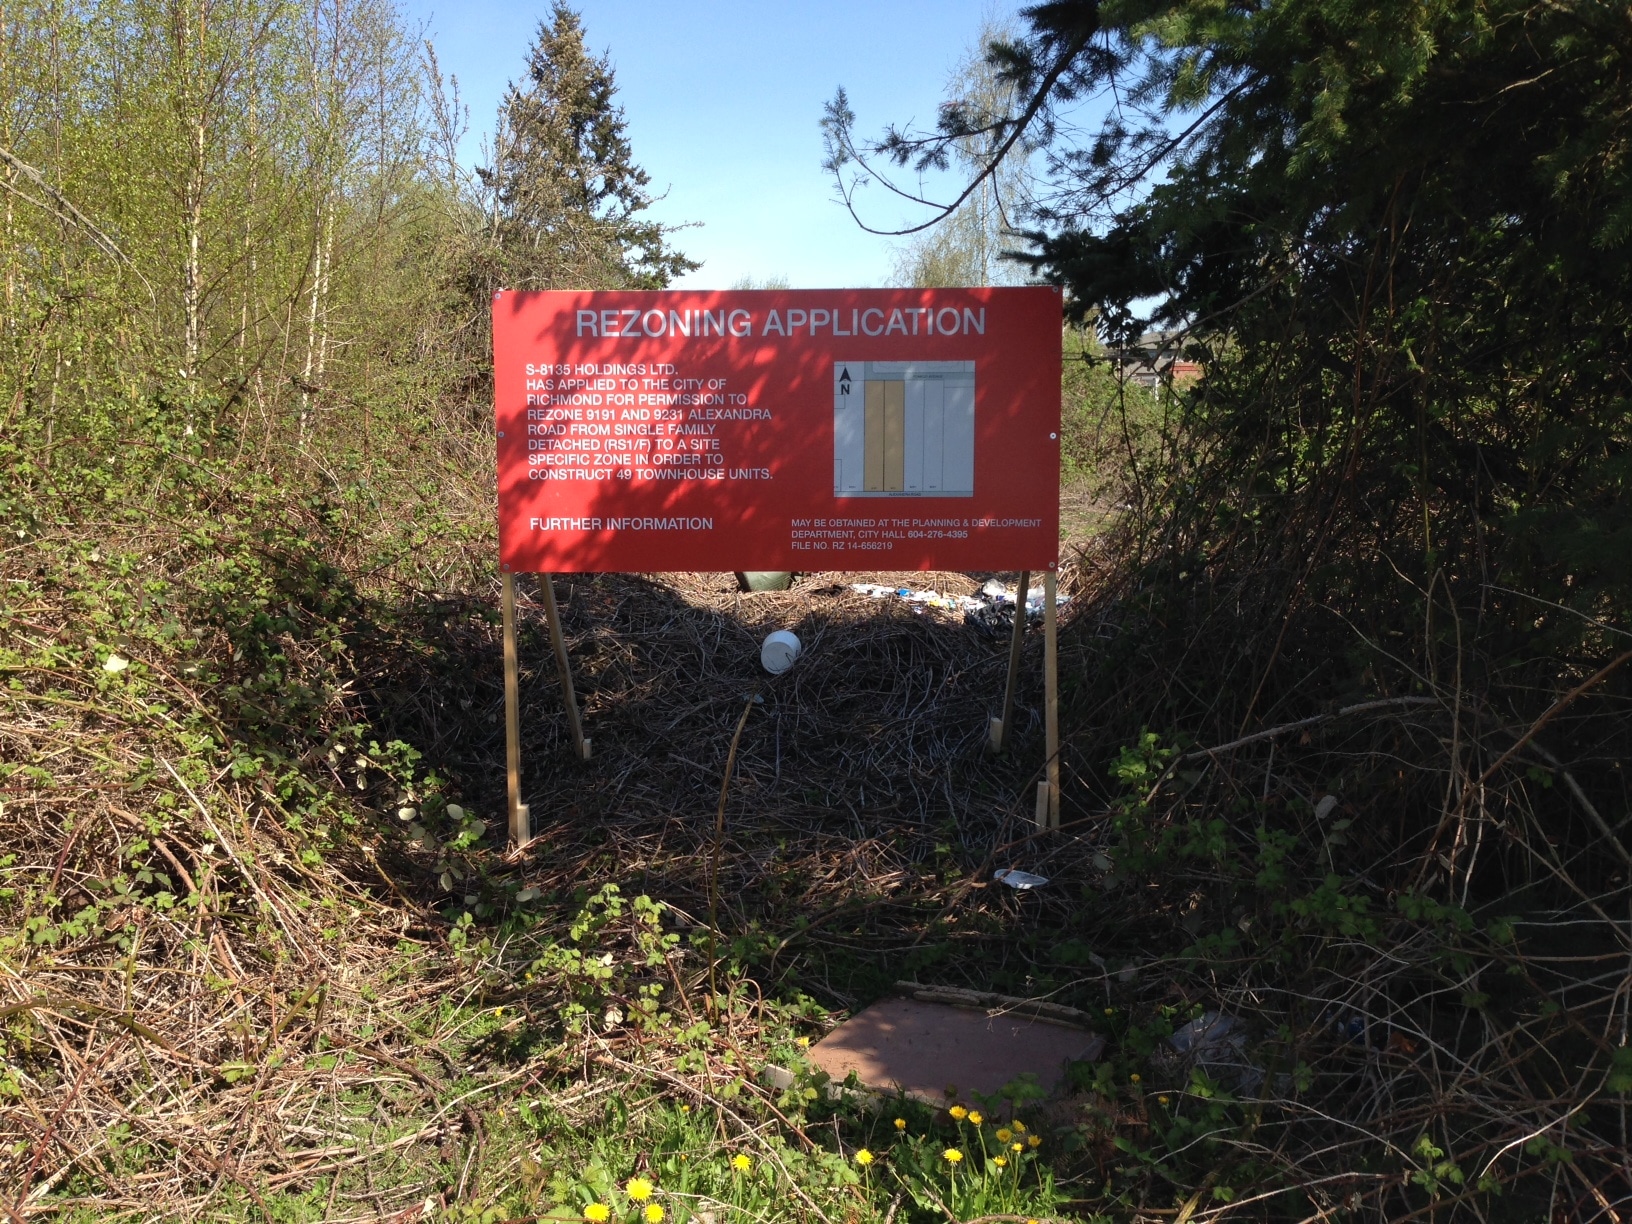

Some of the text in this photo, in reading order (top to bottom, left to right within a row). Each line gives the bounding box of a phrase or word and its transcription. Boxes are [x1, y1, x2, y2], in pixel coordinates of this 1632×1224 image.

[576, 308, 985, 338] REZONING APPLICATION
[525, 364, 679, 375] S-8135 HOLDINGS LTD.
[526, 379, 726, 390] HAS APPLIED TO THE CITY OF
[841, 384, 850, 395] N
[527, 394, 747, 405] RICHMOND FOR PERMISSION TO
[528, 409, 772, 420] REZONE 9191 AND 9231 ALEXANDRA
[528, 424, 716, 435] ROAD FROM SINGLE FAMILY
[528, 439, 719, 452] DETACHED (RS1/F) TO A SITE
[528, 454, 723, 465] SPECIFIC ZONE IN ORDER TO
[528, 469, 773, 480] CONSTRUCT 49 TOWNHOUSE UNITS.
[530, 517, 713, 531] FURTHER INFORMATION
[792, 519, 1042, 527] MAY BE OBTAINED AT THE PLANNING & DEVELOPMENT
[792, 530, 968, 539] DEPARTMENT, CITY HALL 604-276-4395
[832, 541, 845, 549] RZ
[847, 541, 893, 550] 14-656219
